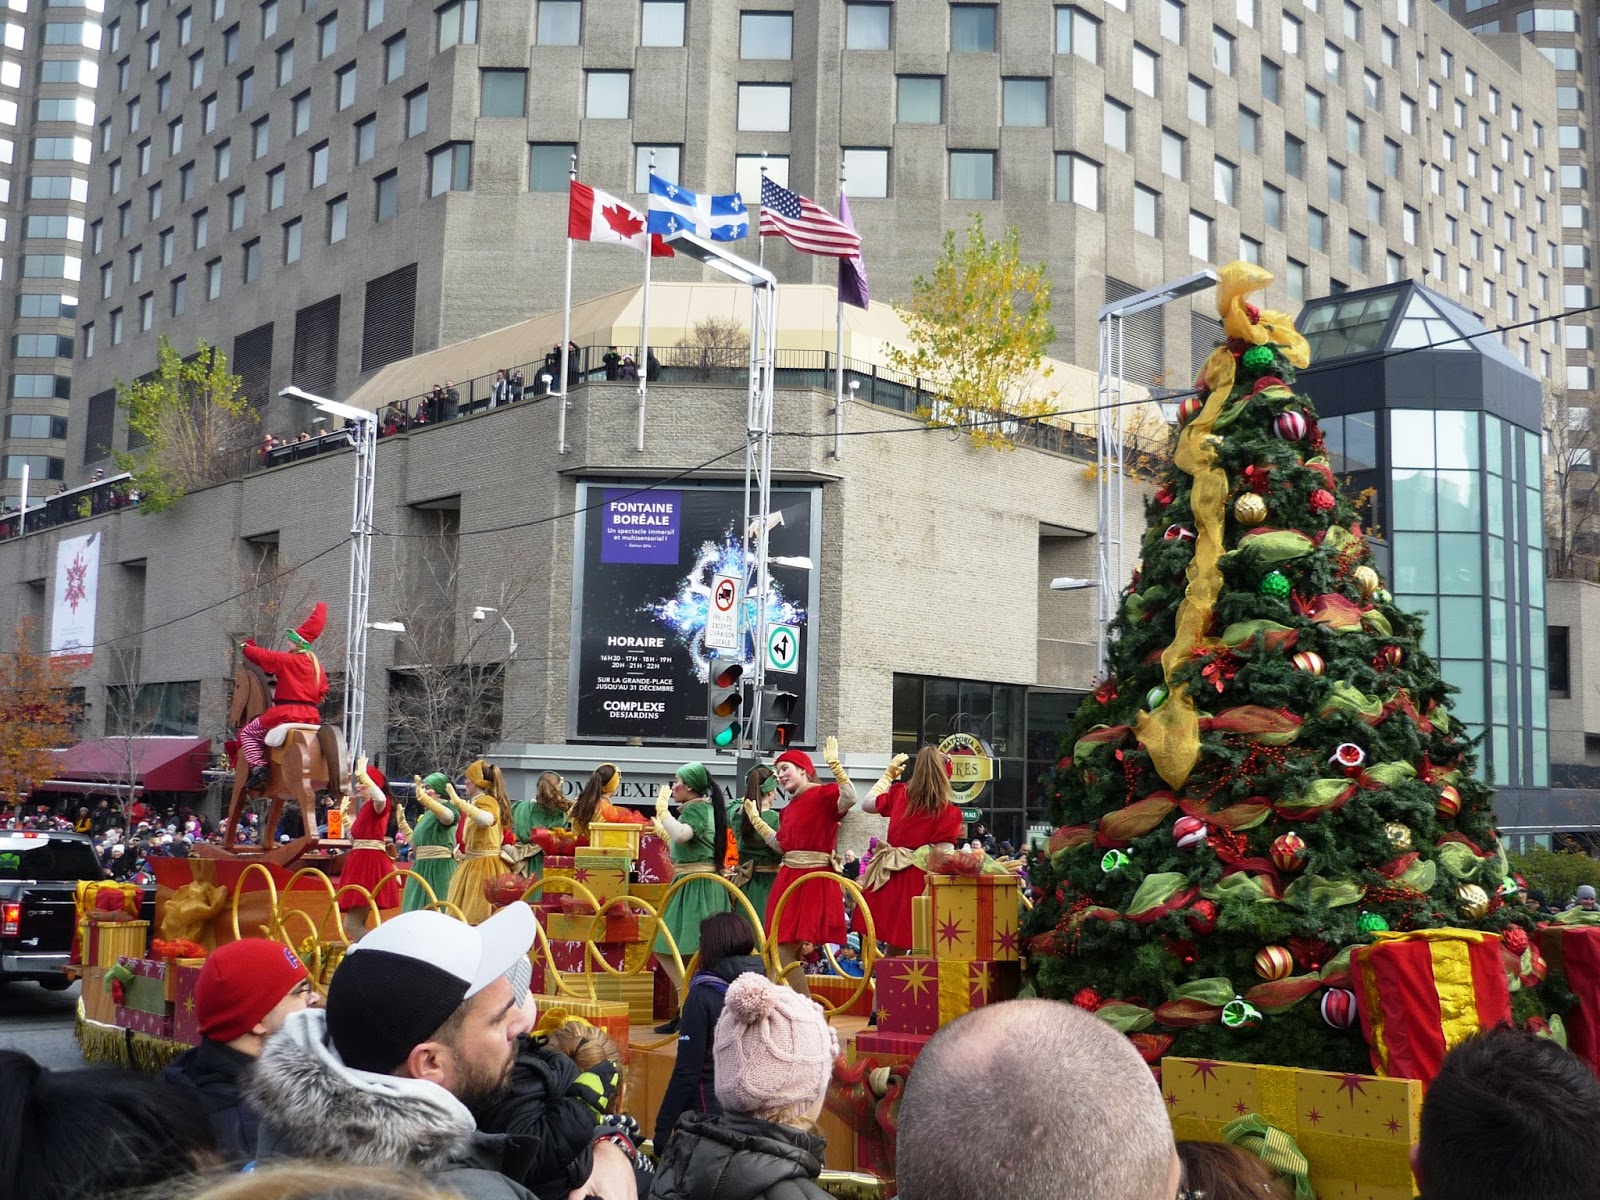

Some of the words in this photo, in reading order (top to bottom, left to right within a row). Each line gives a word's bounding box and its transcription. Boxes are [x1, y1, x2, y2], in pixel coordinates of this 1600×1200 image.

[610, 502, 673, 513] FONTAINE
[613, 514, 669, 526] BORÉALE
[618, 528, 646, 536] spectacle
[712, 638, 730, 646] LOCALE
[639, 684, 674, 692] DÉCEMBRE
[604, 700, 666, 712] COMPLEXE
[610, 711, 659, 719] DESJARDINS
[940, 736, 974, 752] TRATTORIA
[974, 744, 982, 754] DI
[952, 762, 978, 776] KES
